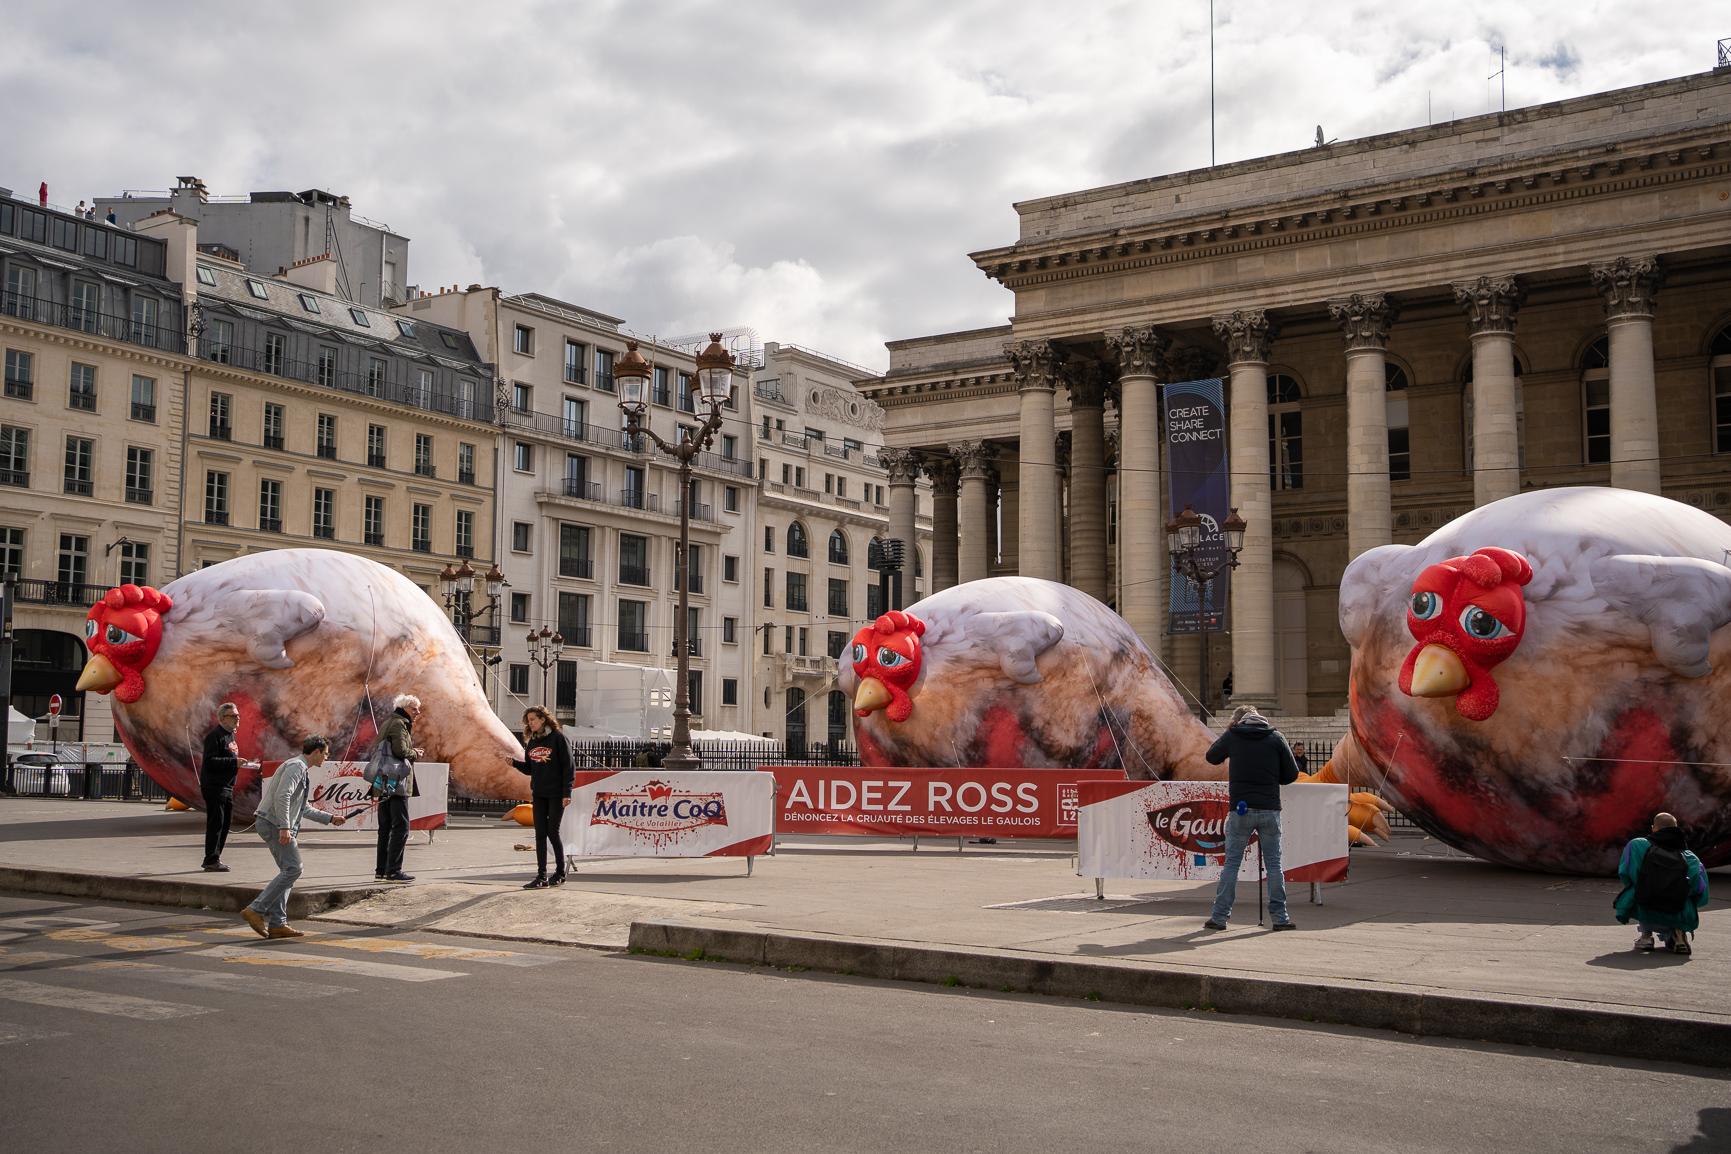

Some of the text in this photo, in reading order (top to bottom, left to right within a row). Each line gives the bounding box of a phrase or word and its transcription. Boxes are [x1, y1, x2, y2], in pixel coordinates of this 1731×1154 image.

[1169, 406, 1209, 419] CREATE
[1170, 419, 1204, 431] SHARE
[1171, 429, 1221, 443] CONNECT
[785, 780, 1039, 813] AIDEZ ROSS
[596, 799, 668, 819] Maître
[784, 811, 1041, 826] DÉNONCEZ LA CRUAUTÉ DES ÉLEVAGES LE GAULOIS
[1155, 807, 1230, 843] le Gau
